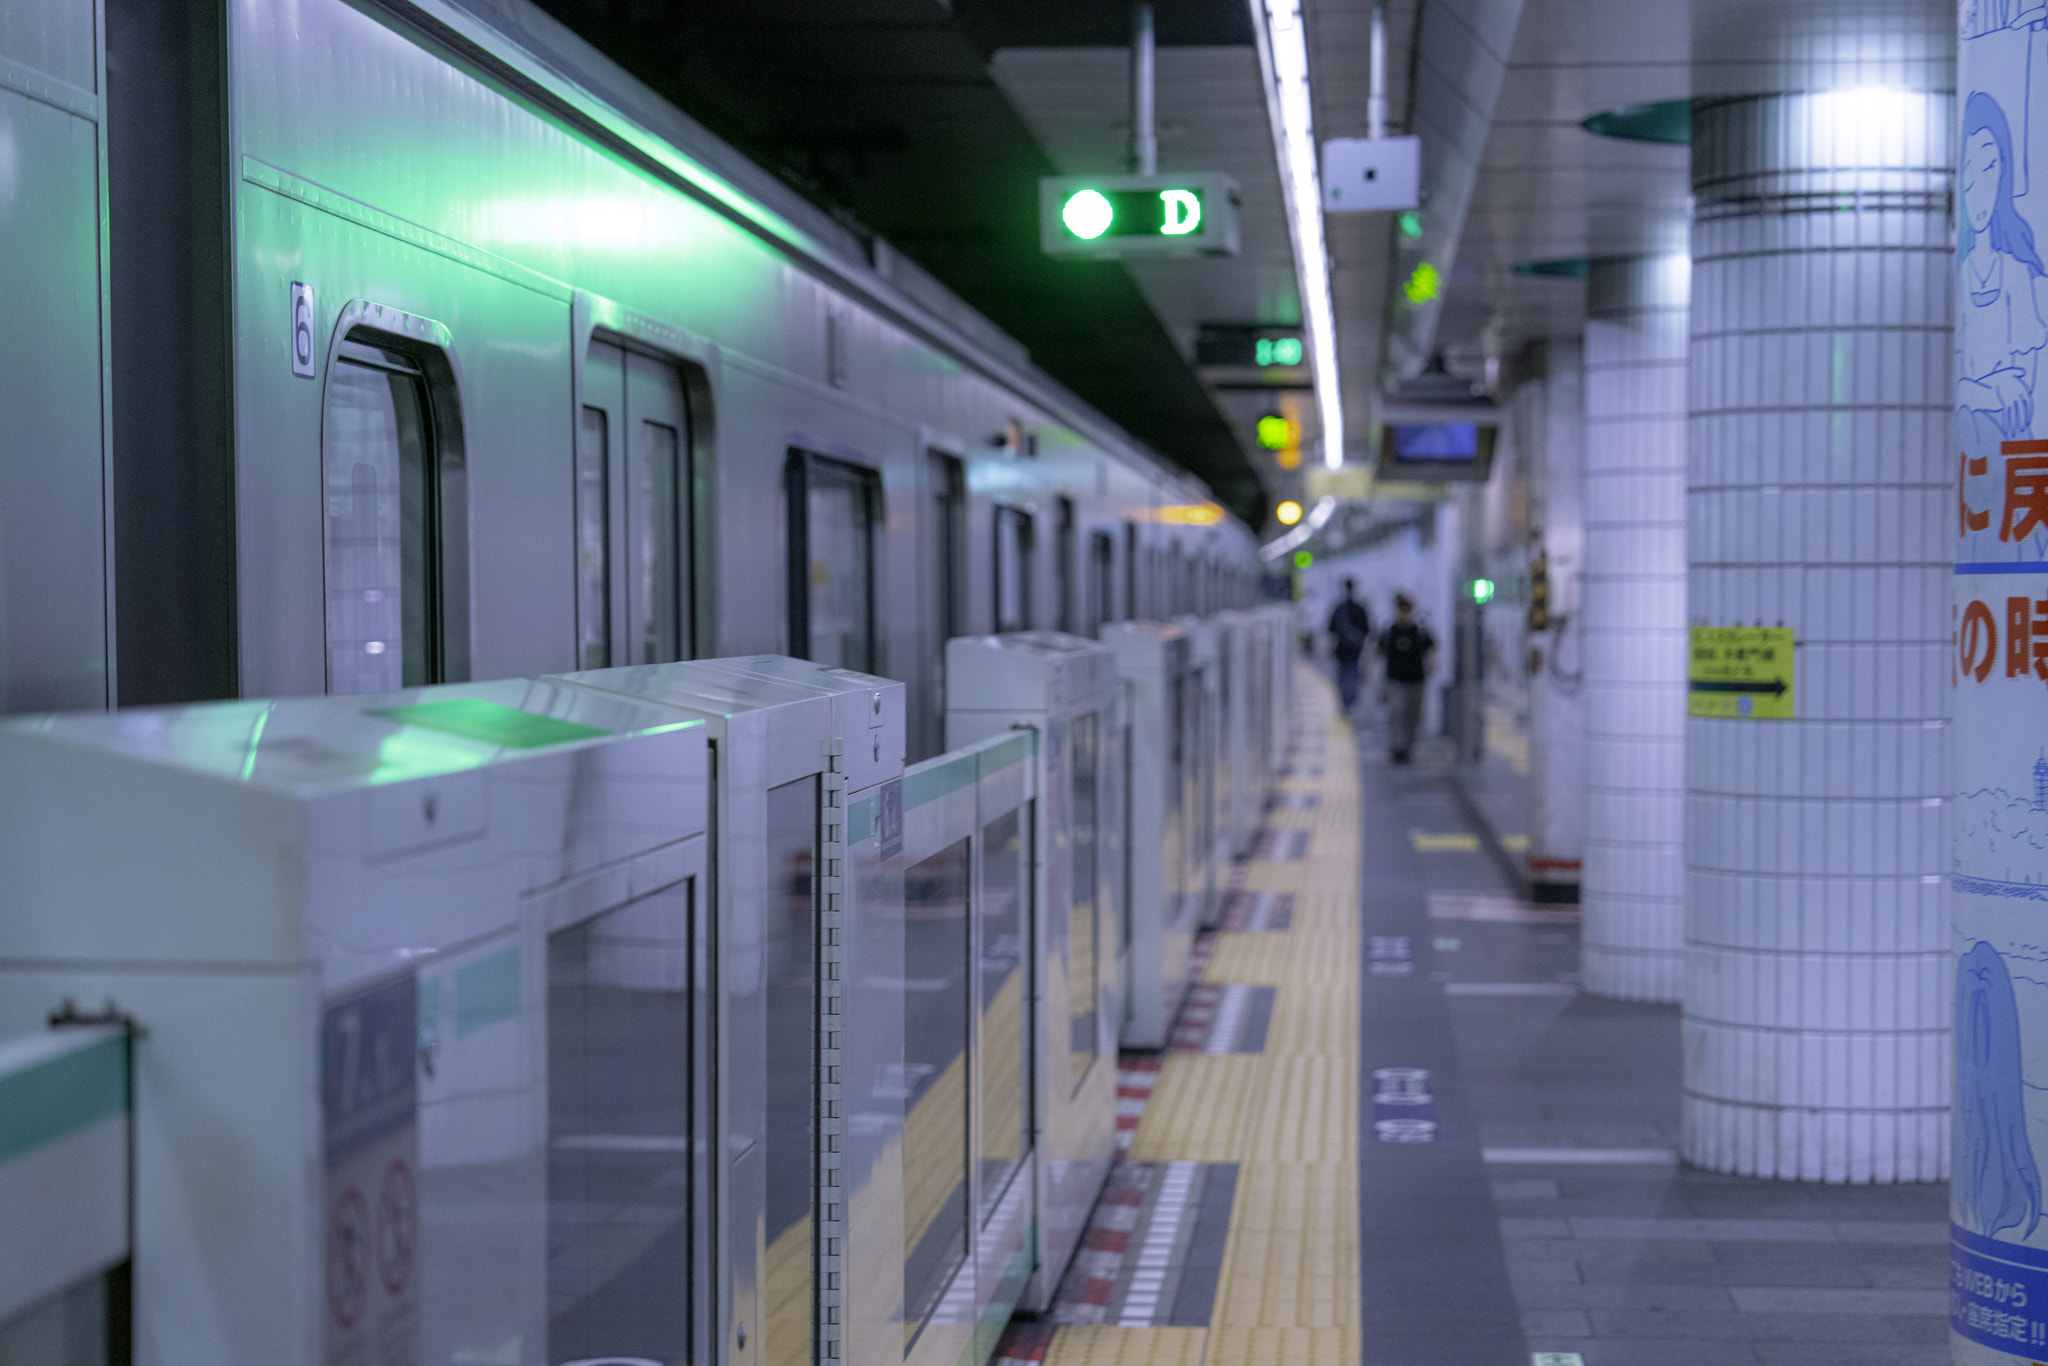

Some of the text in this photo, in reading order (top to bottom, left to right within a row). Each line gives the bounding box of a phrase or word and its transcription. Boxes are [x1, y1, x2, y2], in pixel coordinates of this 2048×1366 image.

[1160, 189, 1201, 235] D
[296, 295, 311, 366] 6
[1952, 588, 2048, 690] の時
